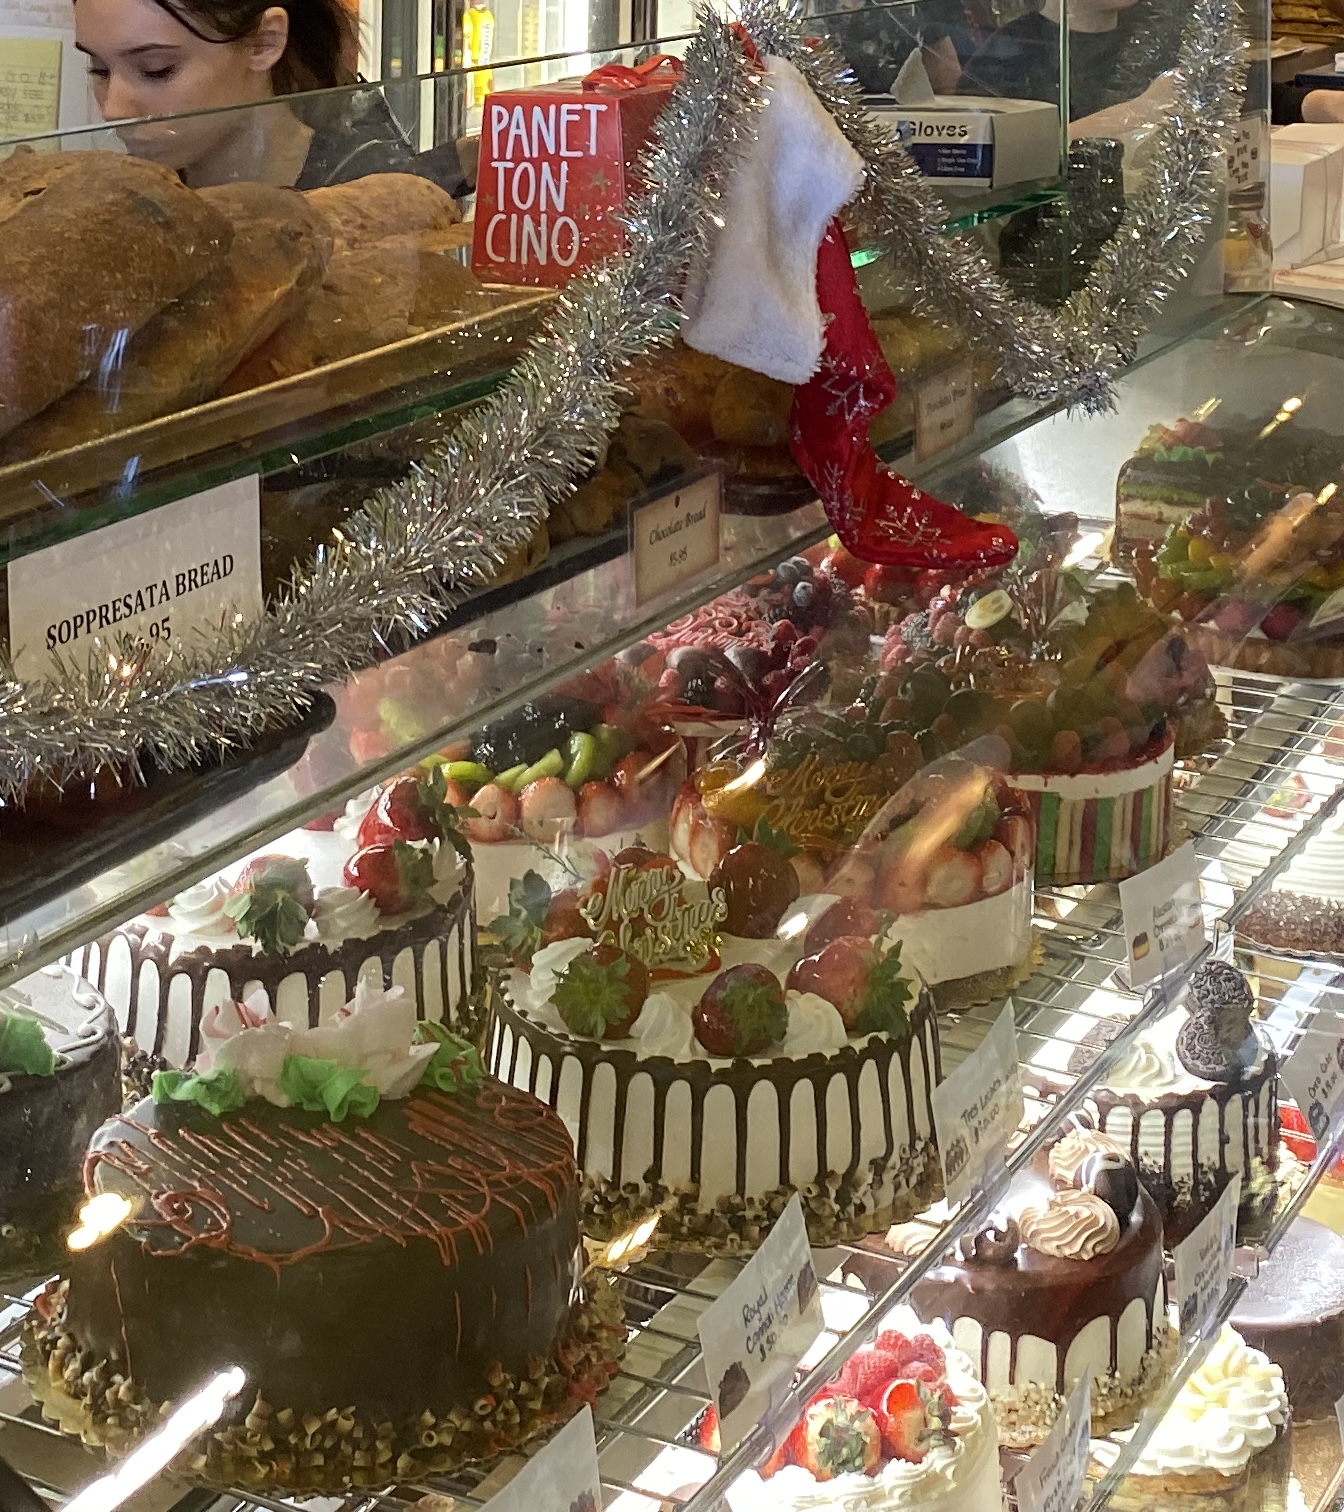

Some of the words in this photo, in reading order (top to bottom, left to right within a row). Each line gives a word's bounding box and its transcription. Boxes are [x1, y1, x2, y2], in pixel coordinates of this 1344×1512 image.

[491, 103, 608, 160] PANET
[490, 160, 569, 213] TON
[485, 212, 580, 268] CINO
[46, 579, 171, 651] SOPPRESATA
[175, 553, 235, 598] BREAD
